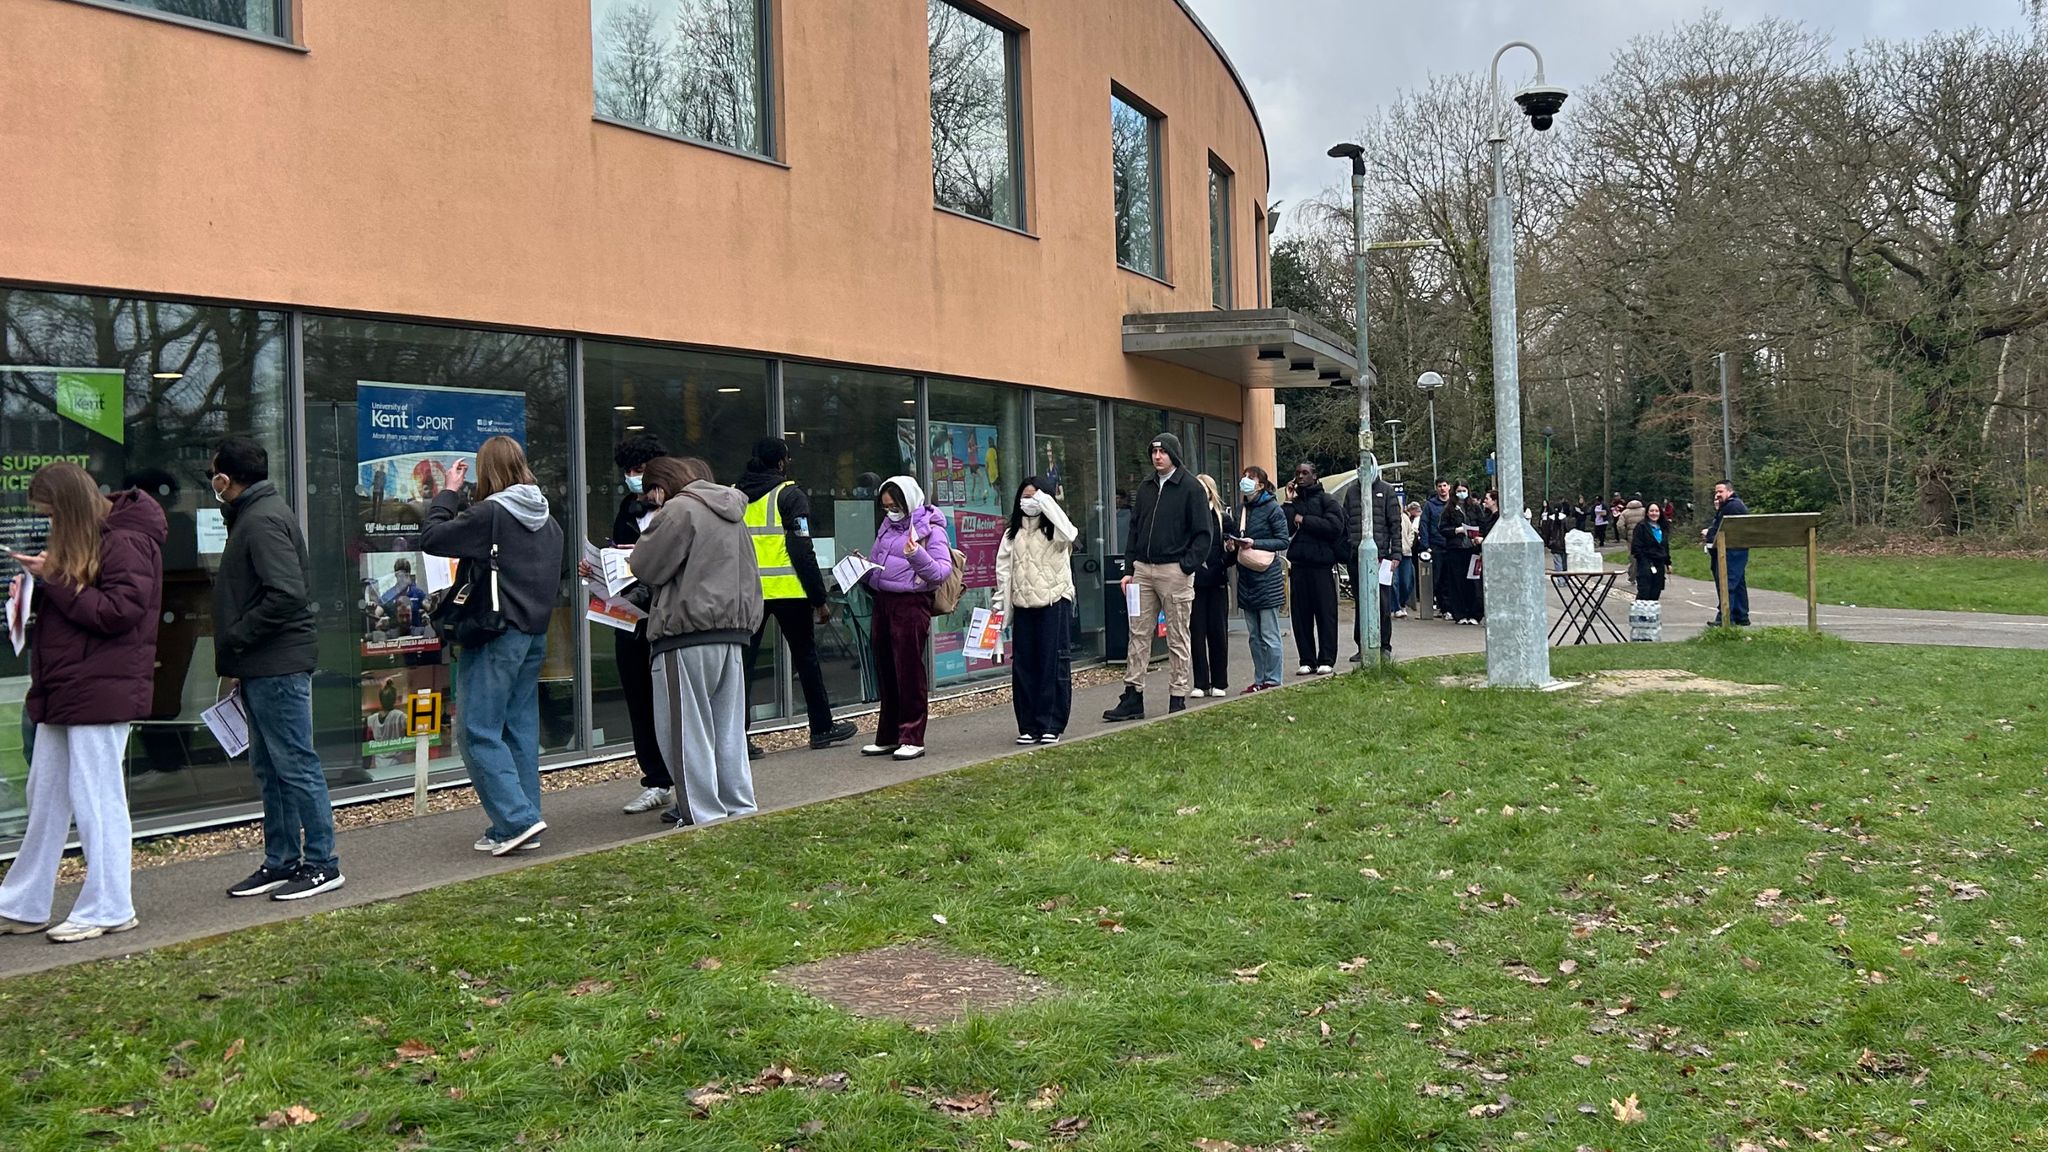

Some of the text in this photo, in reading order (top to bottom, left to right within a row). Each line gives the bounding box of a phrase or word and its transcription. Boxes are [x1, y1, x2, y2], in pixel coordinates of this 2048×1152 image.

[371, 402, 408, 412] University of
[371, 410, 409, 429] Kent
[416, 415, 455, 430] SPORT
[411, 697, 437, 732] H
